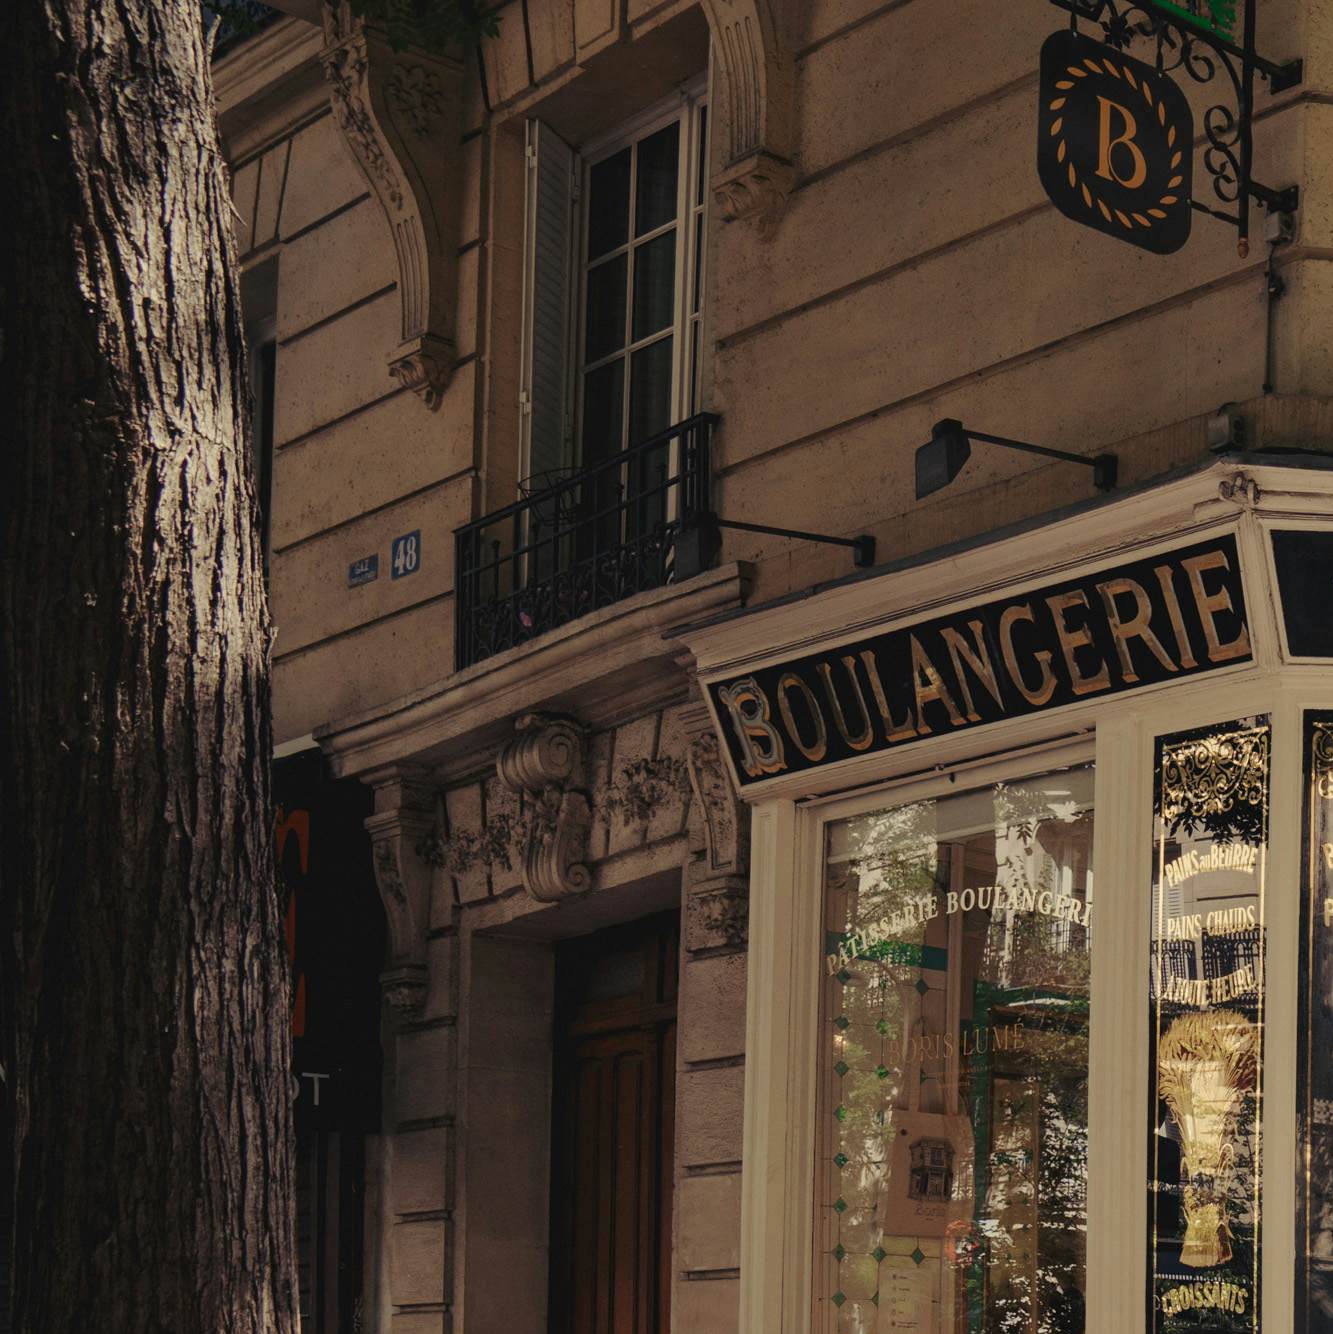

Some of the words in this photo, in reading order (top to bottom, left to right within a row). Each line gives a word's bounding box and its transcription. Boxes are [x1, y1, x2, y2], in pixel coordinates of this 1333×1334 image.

[1095, 95, 1147, 189] B
[394, 536, 417, 575] 48
[718, 549, 1250, 778] BOULANGERIE
[1165, 849, 1199, 888] PAINS
[1210, 843, 1259, 874] BEURRE
[826, 896, 938, 977] PÂTISSERIE
[1167, 914, 1201, 942] PAINS
[1206, 905, 1256, 936] CHAUDS
[963, 1017, 1025, 1056] LUMÉ
[1161, 1280, 1248, 1317] CROISSANTS
